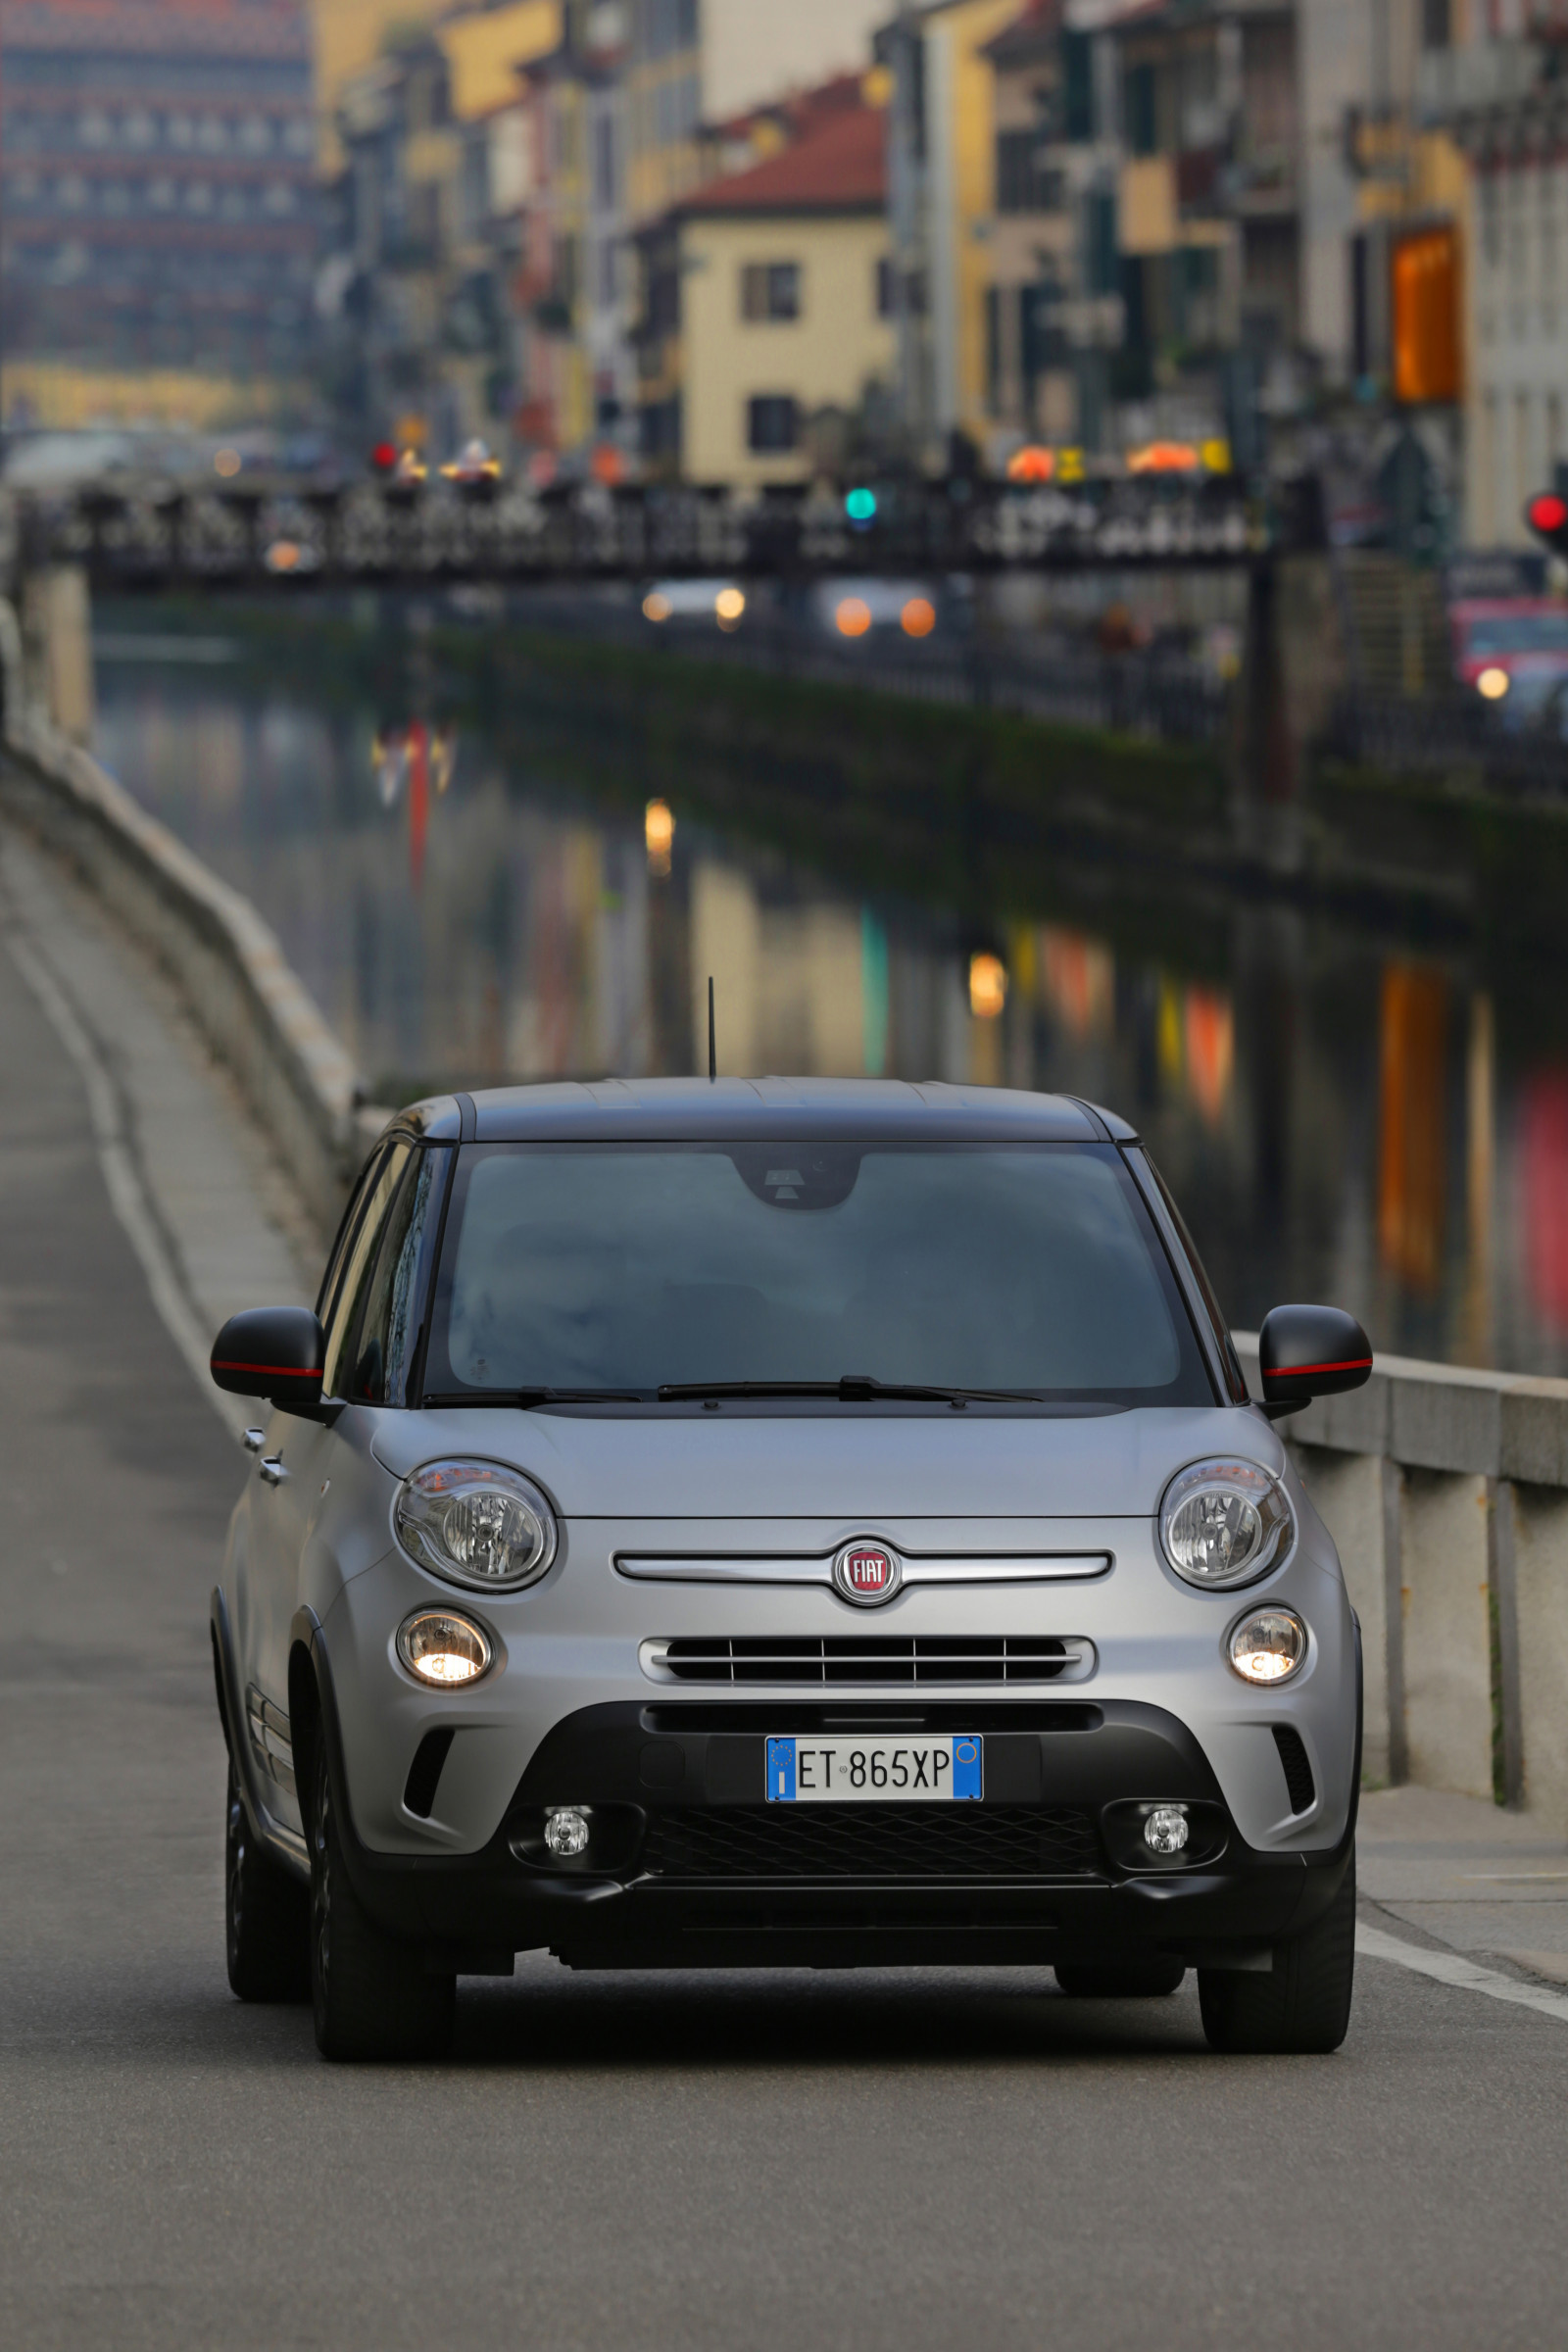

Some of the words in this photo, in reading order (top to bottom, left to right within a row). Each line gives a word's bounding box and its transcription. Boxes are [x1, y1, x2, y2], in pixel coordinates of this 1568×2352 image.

[853, 1559, 884, 1583] FIAT
[799, 1750, 837, 1788] ET
[850, 1749, 950, 1788] 865XP
[778, 1771, 786, 1794] I
